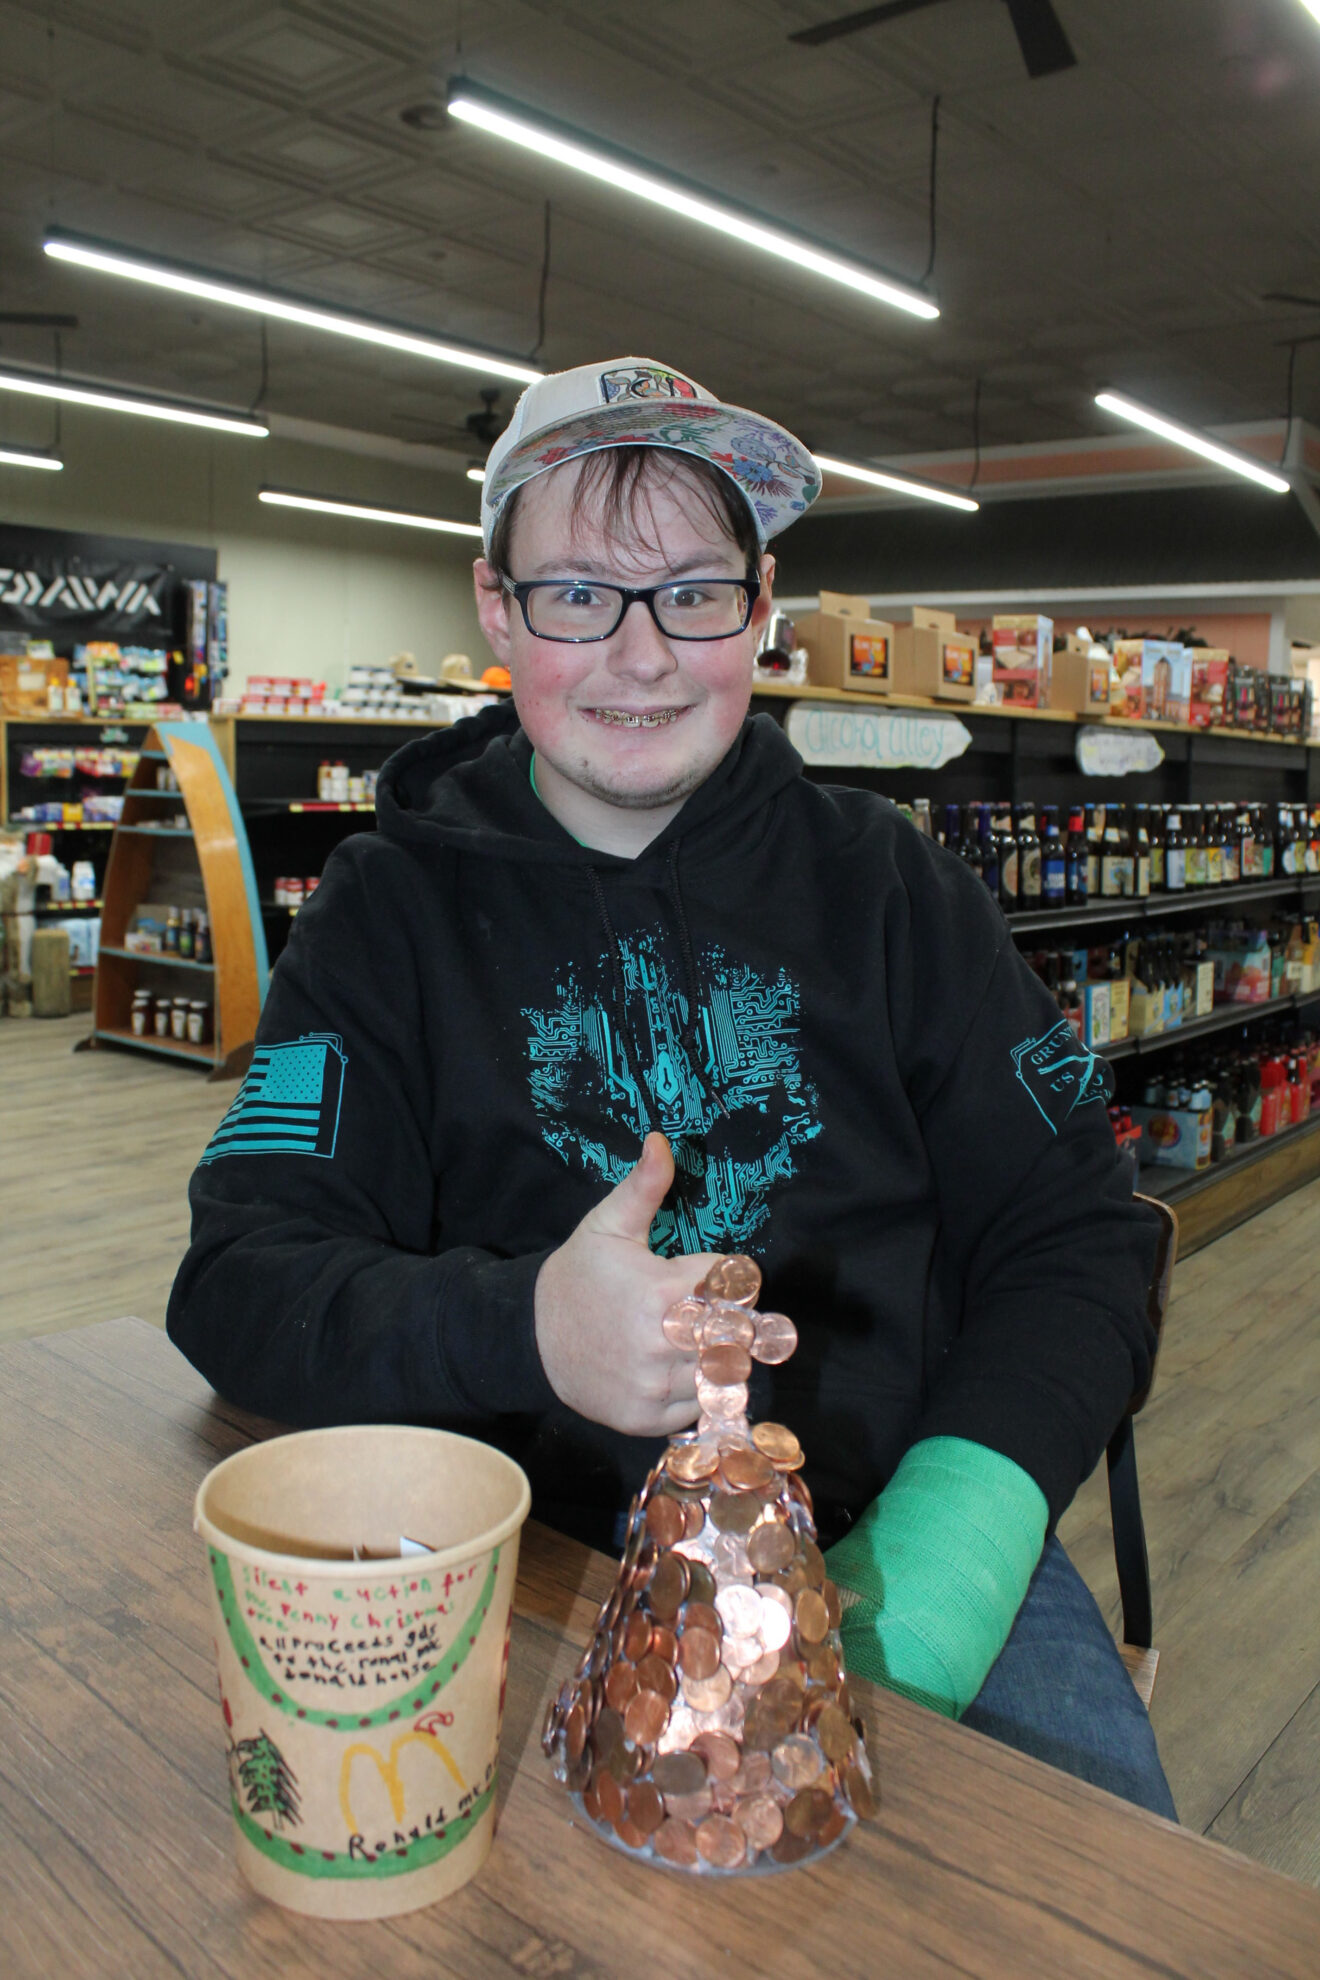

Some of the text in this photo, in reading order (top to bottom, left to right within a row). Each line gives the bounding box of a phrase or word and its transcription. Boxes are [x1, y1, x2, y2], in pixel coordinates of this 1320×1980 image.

[1031, 1025, 1072, 1065] GRUN
[1050, 1071, 1075, 1092] US
[442, 1564, 477, 1598] for
[348, 1807, 447, 1861] Ronald
